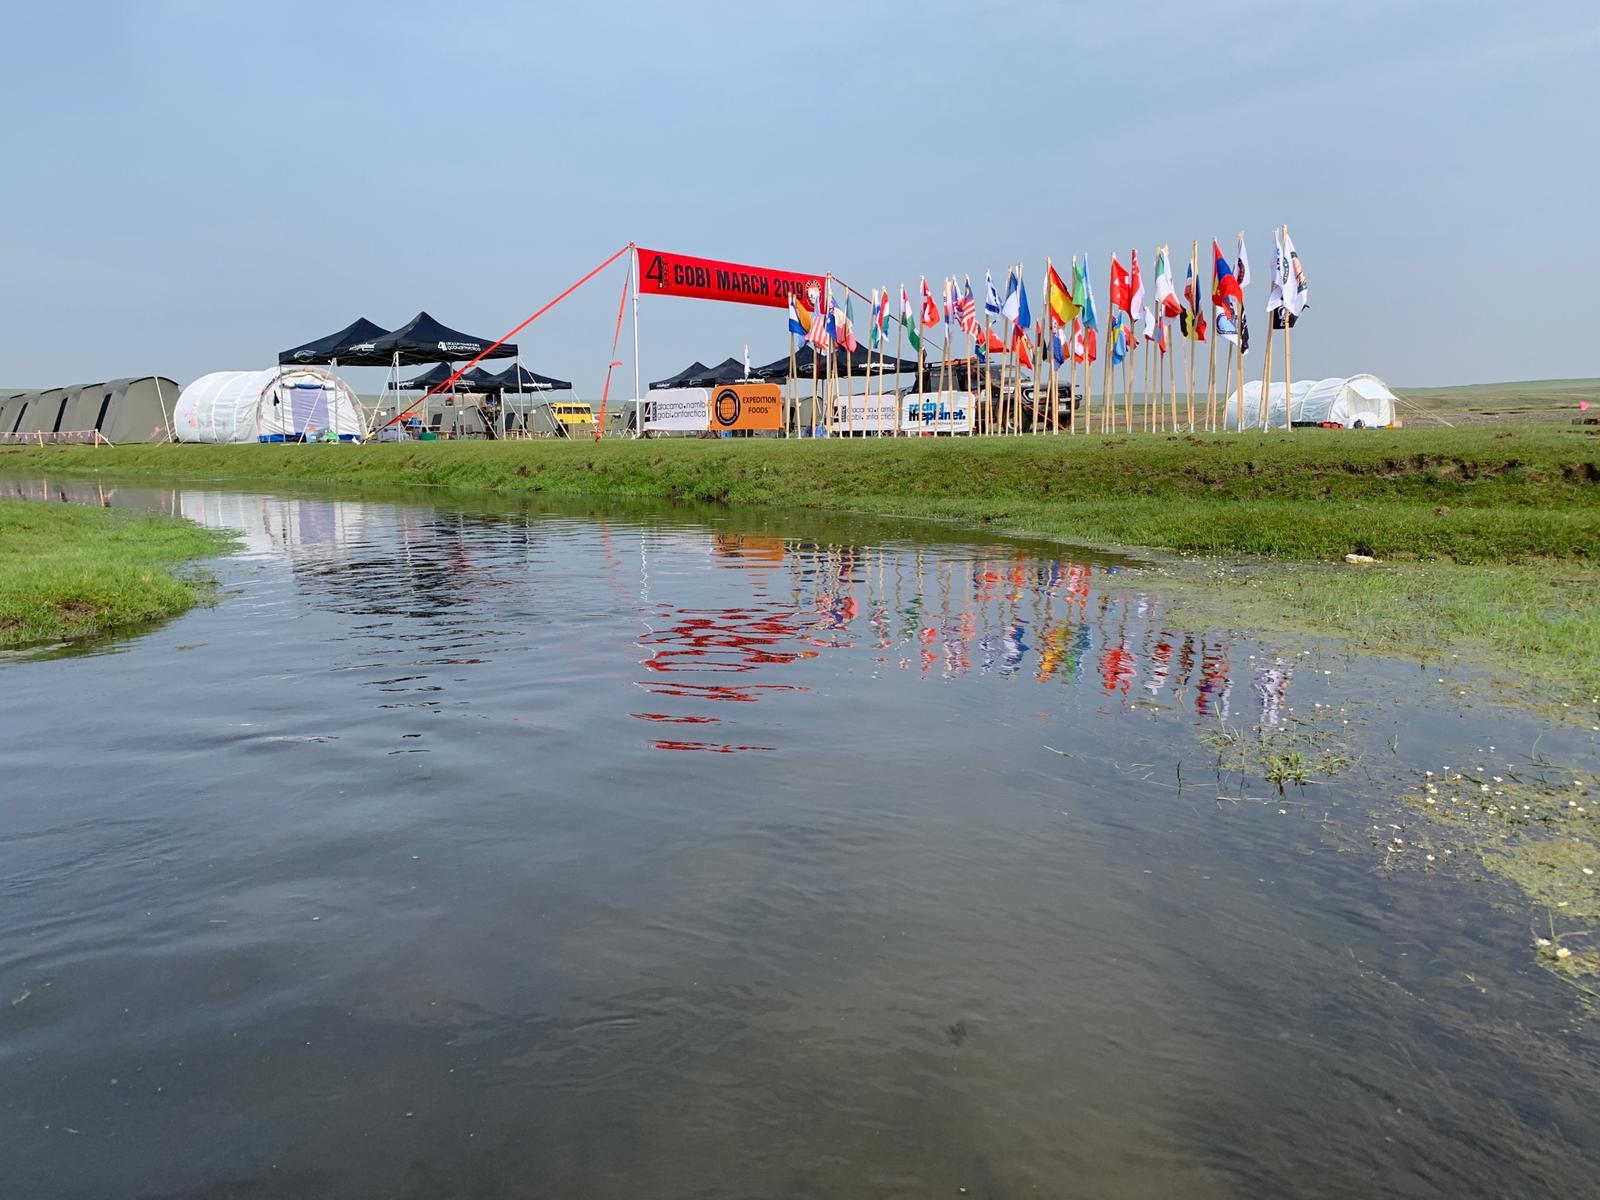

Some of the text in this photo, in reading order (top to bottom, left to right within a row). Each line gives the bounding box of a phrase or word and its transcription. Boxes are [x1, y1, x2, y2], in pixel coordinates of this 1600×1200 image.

[674, 264, 711, 288] GOBI
[716, 269, 769, 296] MARCH
[773, 278, 803, 300] 2019
[742, 396, 777, 404] EXPEDITION
[748, 406, 769, 414] FOODS
